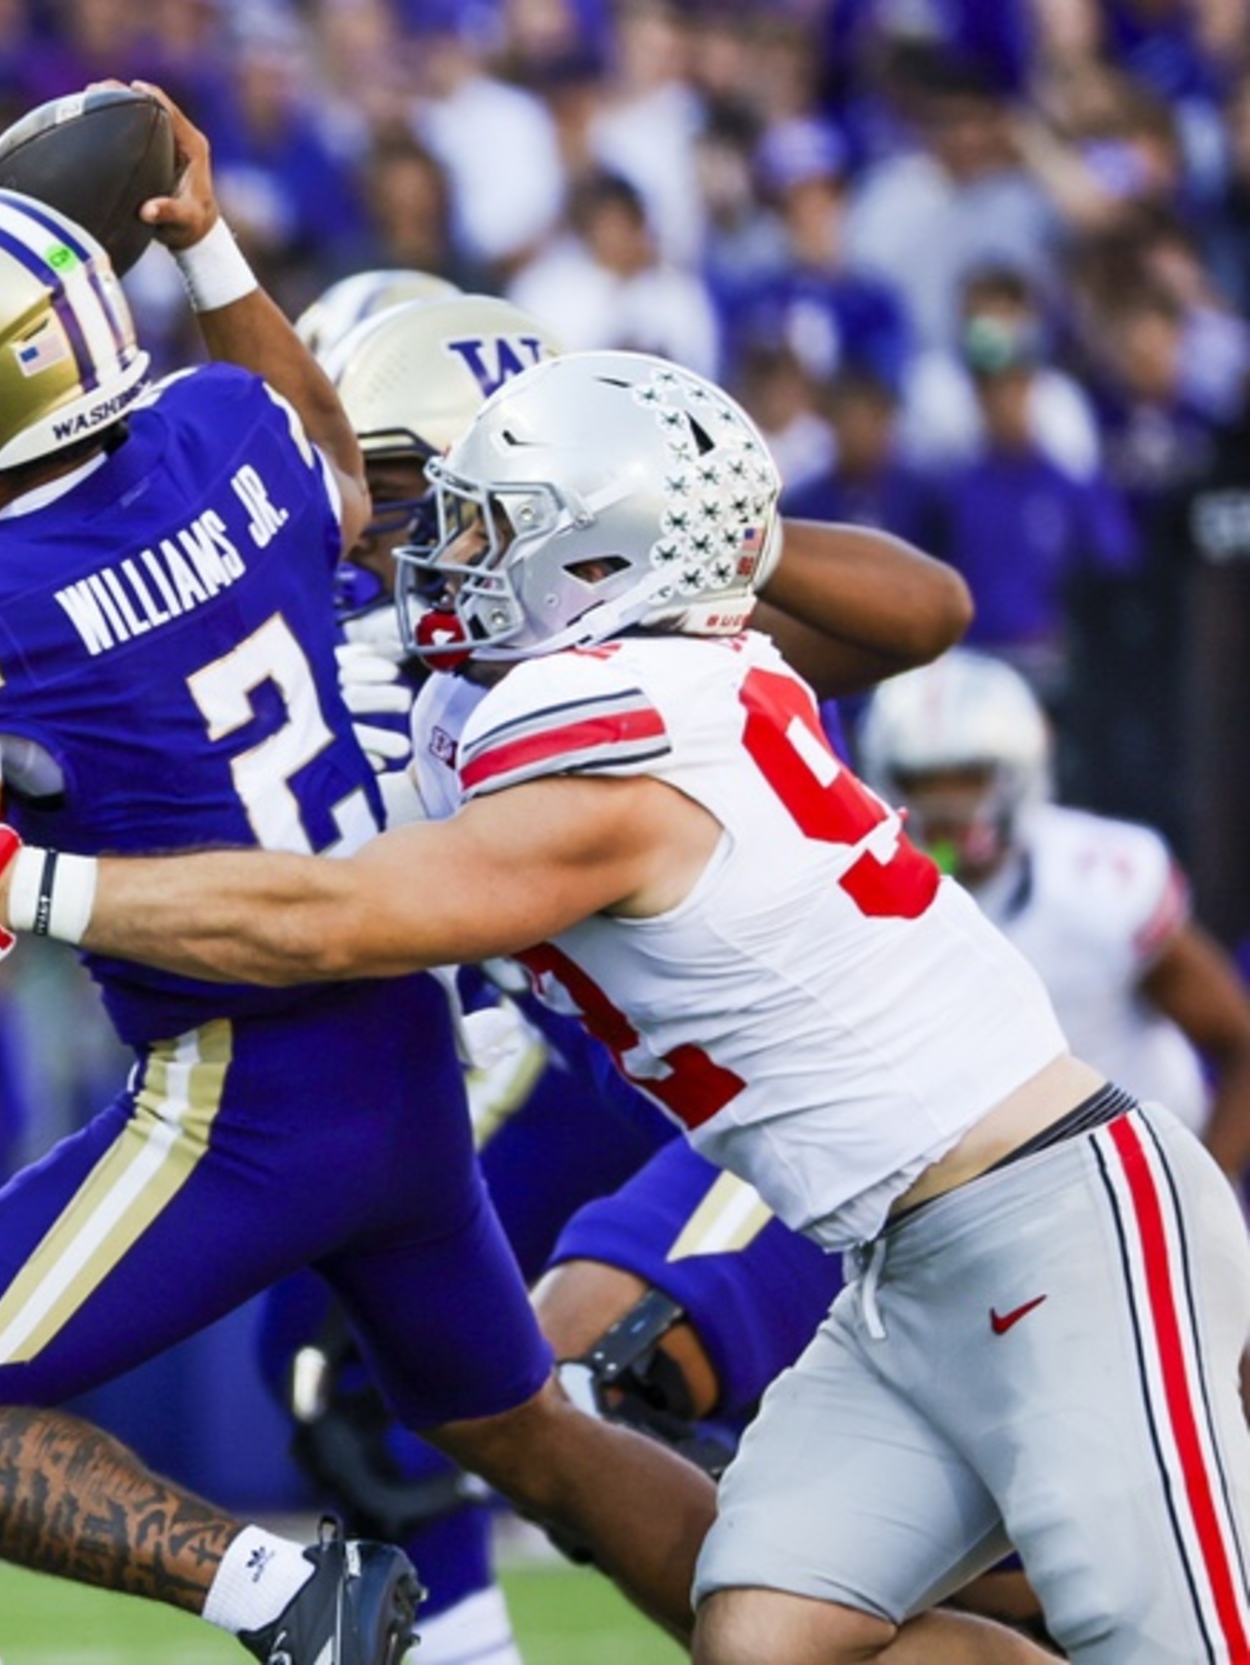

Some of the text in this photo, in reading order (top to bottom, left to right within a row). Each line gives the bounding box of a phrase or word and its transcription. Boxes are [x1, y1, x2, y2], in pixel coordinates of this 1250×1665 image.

[446, 336, 541, 400] W
[54, 508, 246, 656] WILLIAMS
[230, 463, 290, 549] JR.
[185, 610, 378, 860] 2
